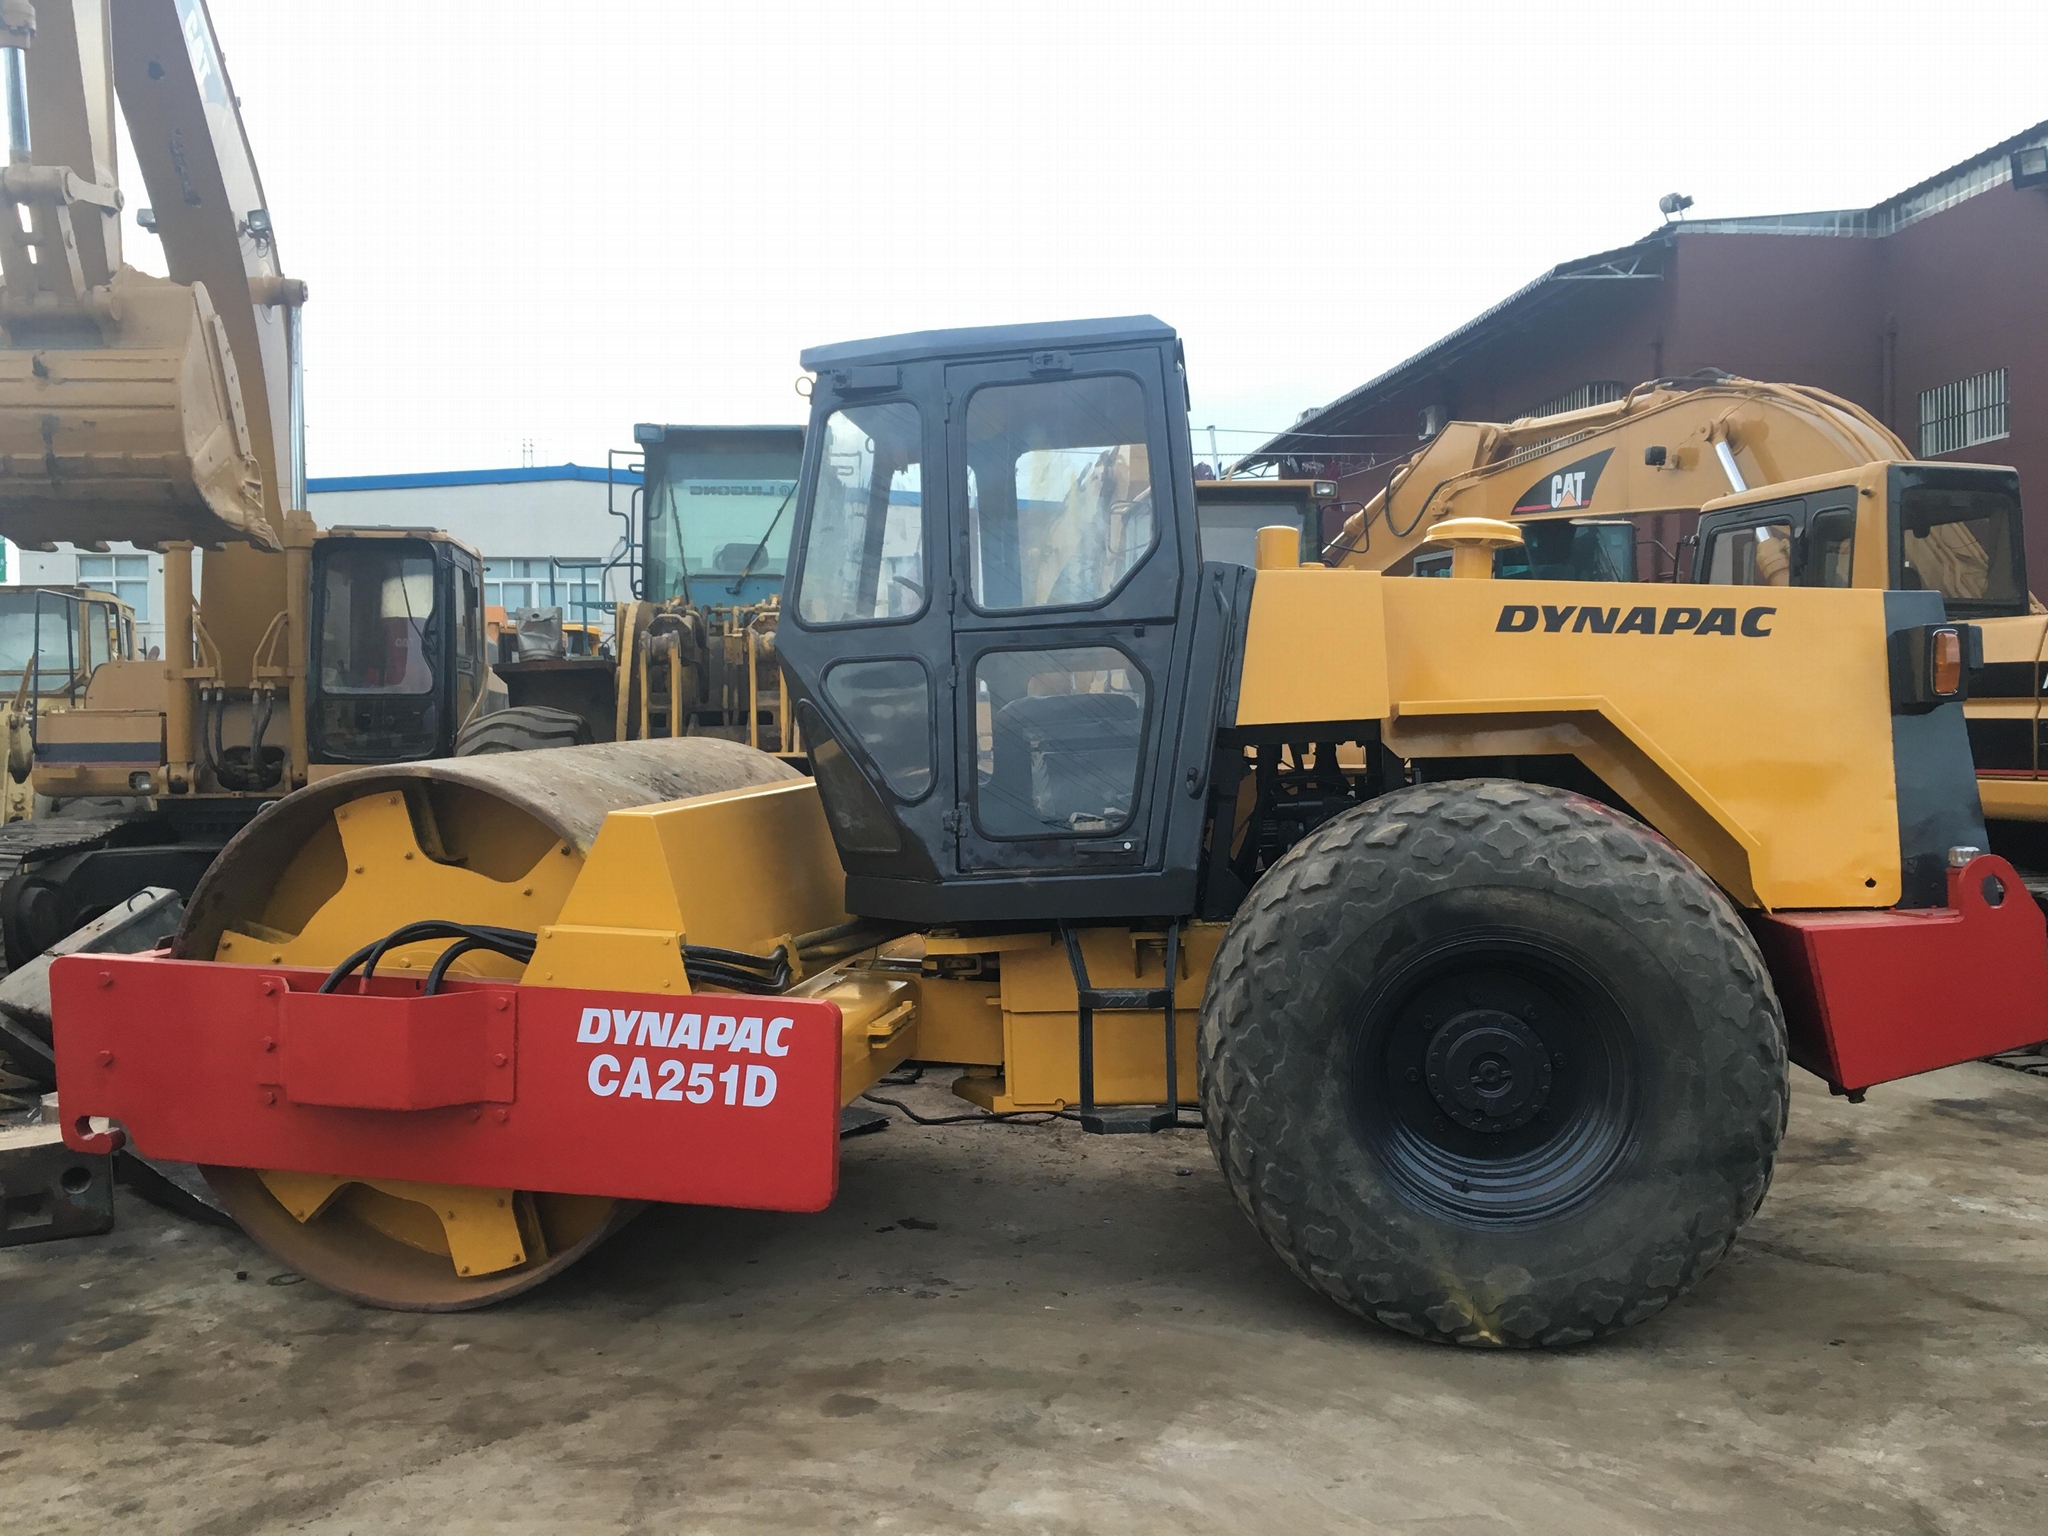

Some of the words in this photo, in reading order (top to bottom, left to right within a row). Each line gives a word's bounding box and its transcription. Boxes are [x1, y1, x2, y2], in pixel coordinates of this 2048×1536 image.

[1550, 471, 1586, 508] CAT
[1494, 604, 1778, 638] DYNAPAC
[576, 1007, 795, 1057] DYNAPAC
[587, 1054, 778, 1107] CA251D
